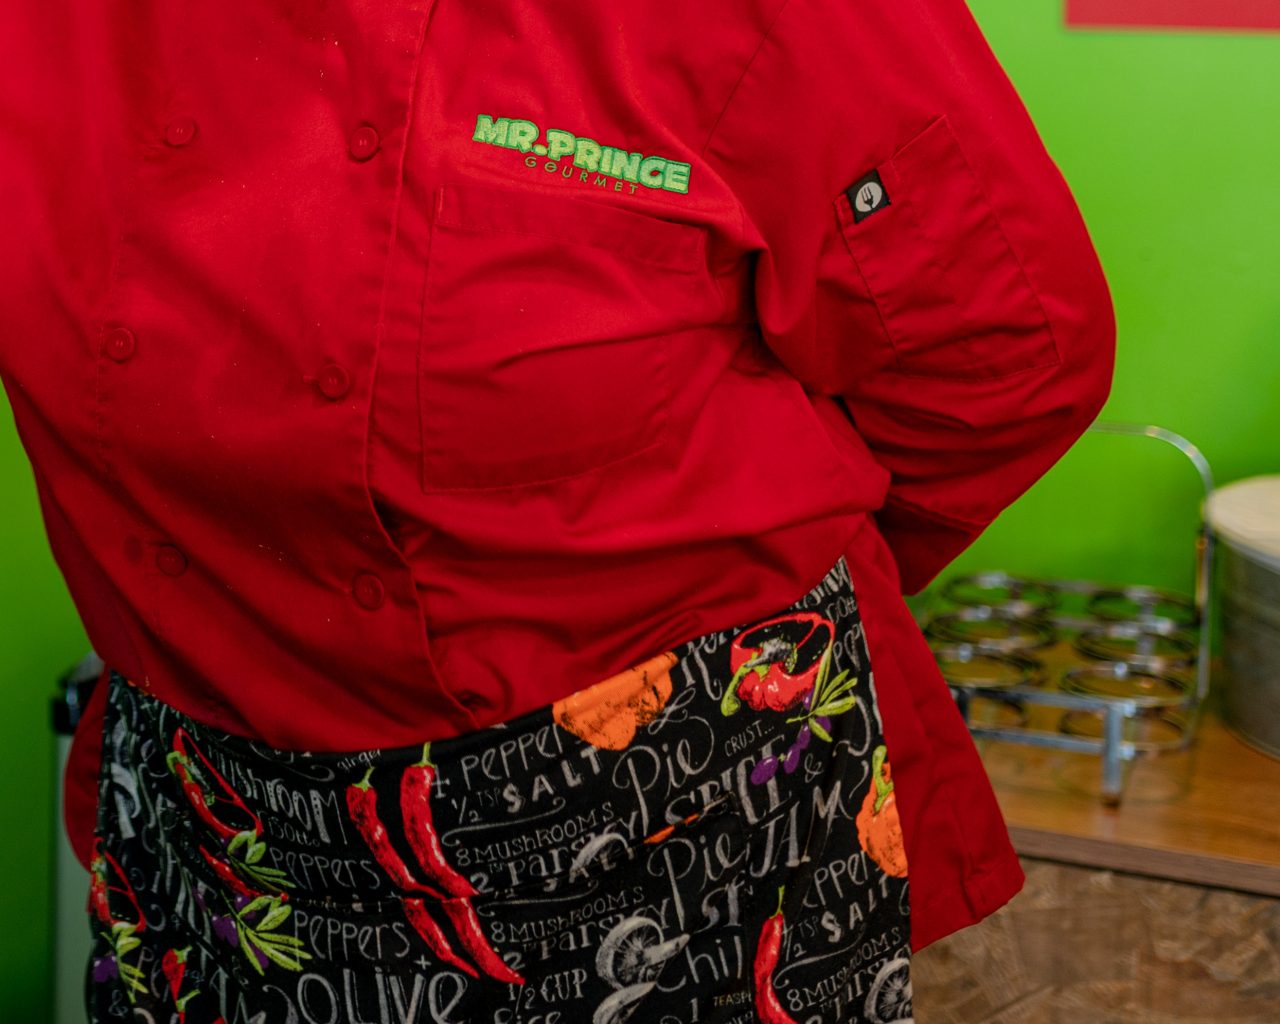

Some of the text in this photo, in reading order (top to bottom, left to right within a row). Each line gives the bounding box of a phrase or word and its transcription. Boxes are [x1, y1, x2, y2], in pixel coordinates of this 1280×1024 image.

[472, 114, 691, 194] MR.PRINCE
[524, 156, 639, 195] GOURMET
[502, 745, 601, 814] SALT
[456, 847, 471, 866] 8
[490, 921, 506, 943] 8
[539, 968, 588, 1003] CUP
[786, 988, 804, 1011] 8
